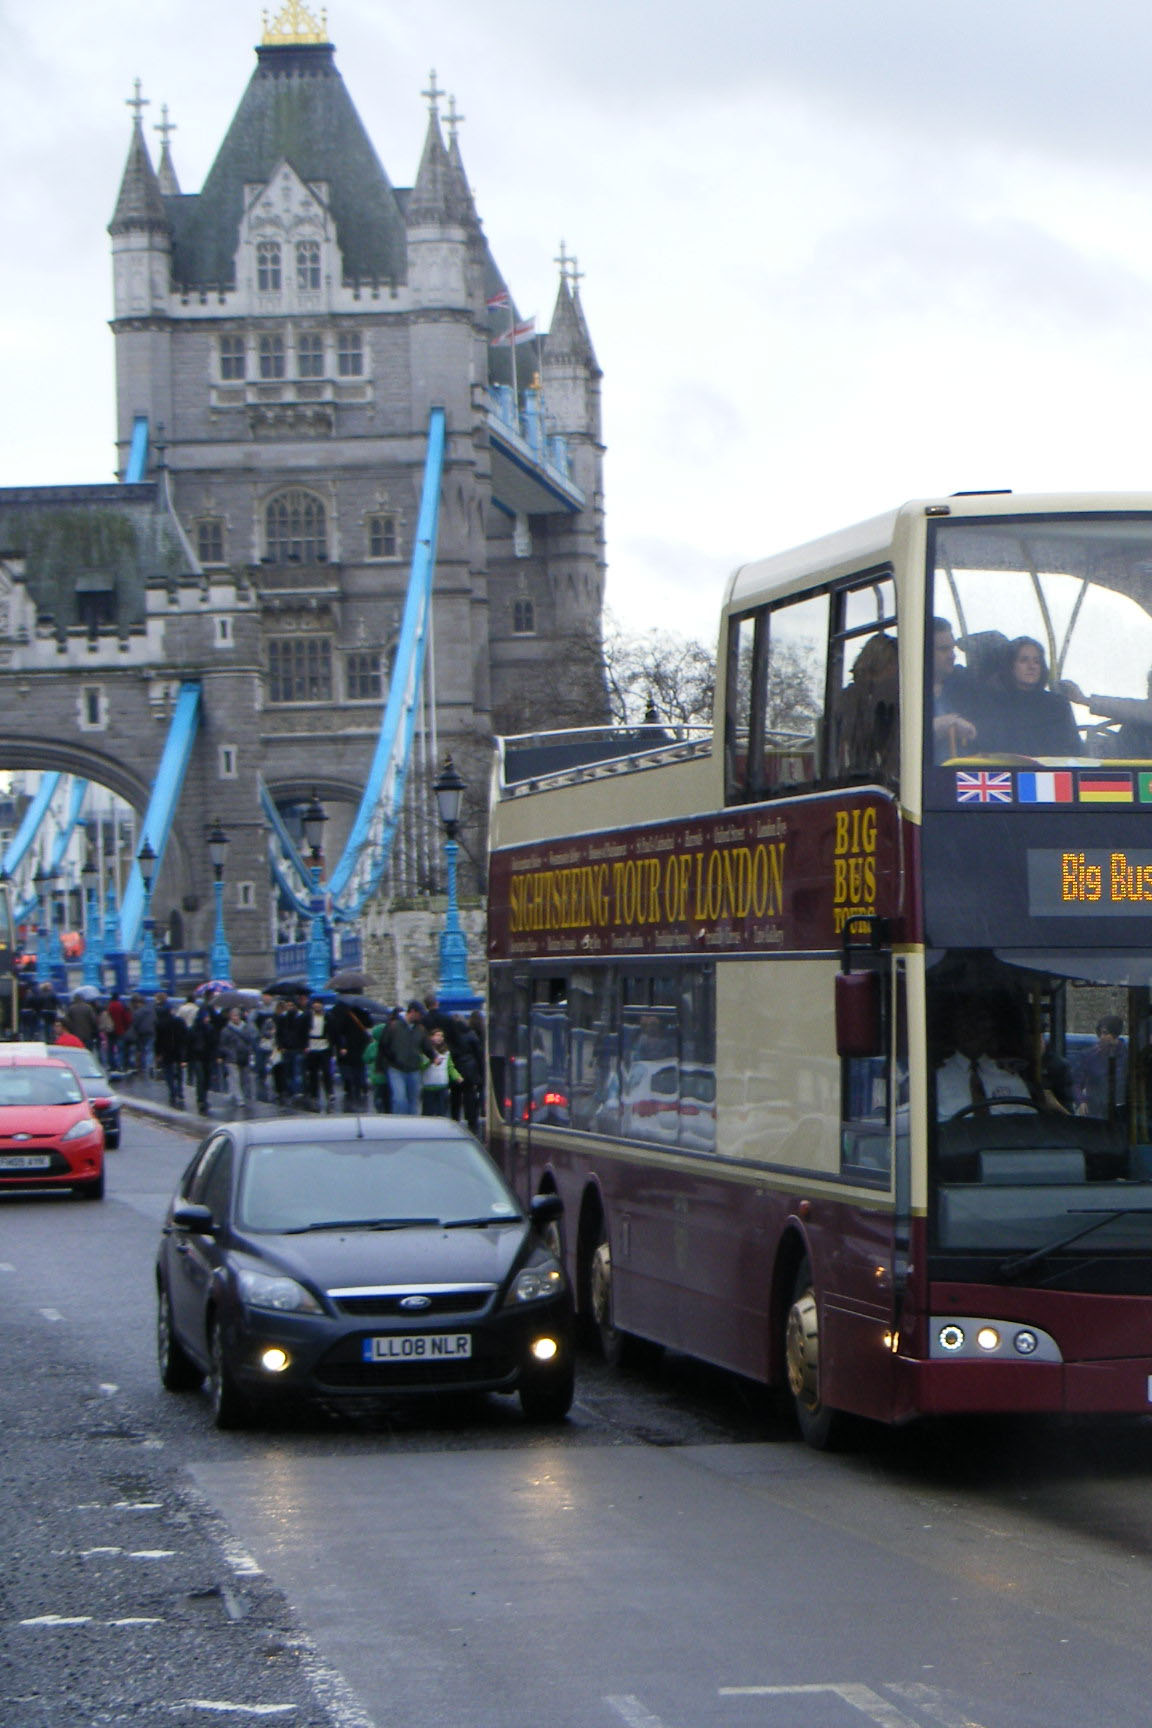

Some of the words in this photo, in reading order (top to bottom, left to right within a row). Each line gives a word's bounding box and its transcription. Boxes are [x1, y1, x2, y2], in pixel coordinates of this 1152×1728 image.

[834, 807, 878, 855] BIG
[510, 863, 611, 933] SIGHTSEEING
[612, 858, 662, 926] TOUR
[664, 853, 692, 924] OF
[695, 843, 787, 921] LONDON
[833, 856, 877, 904] BUS
[1062, 853, 1102, 901] Big
[376, 1338, 427, 1357] LL08
[431, 1336, 469, 1355] NLR
